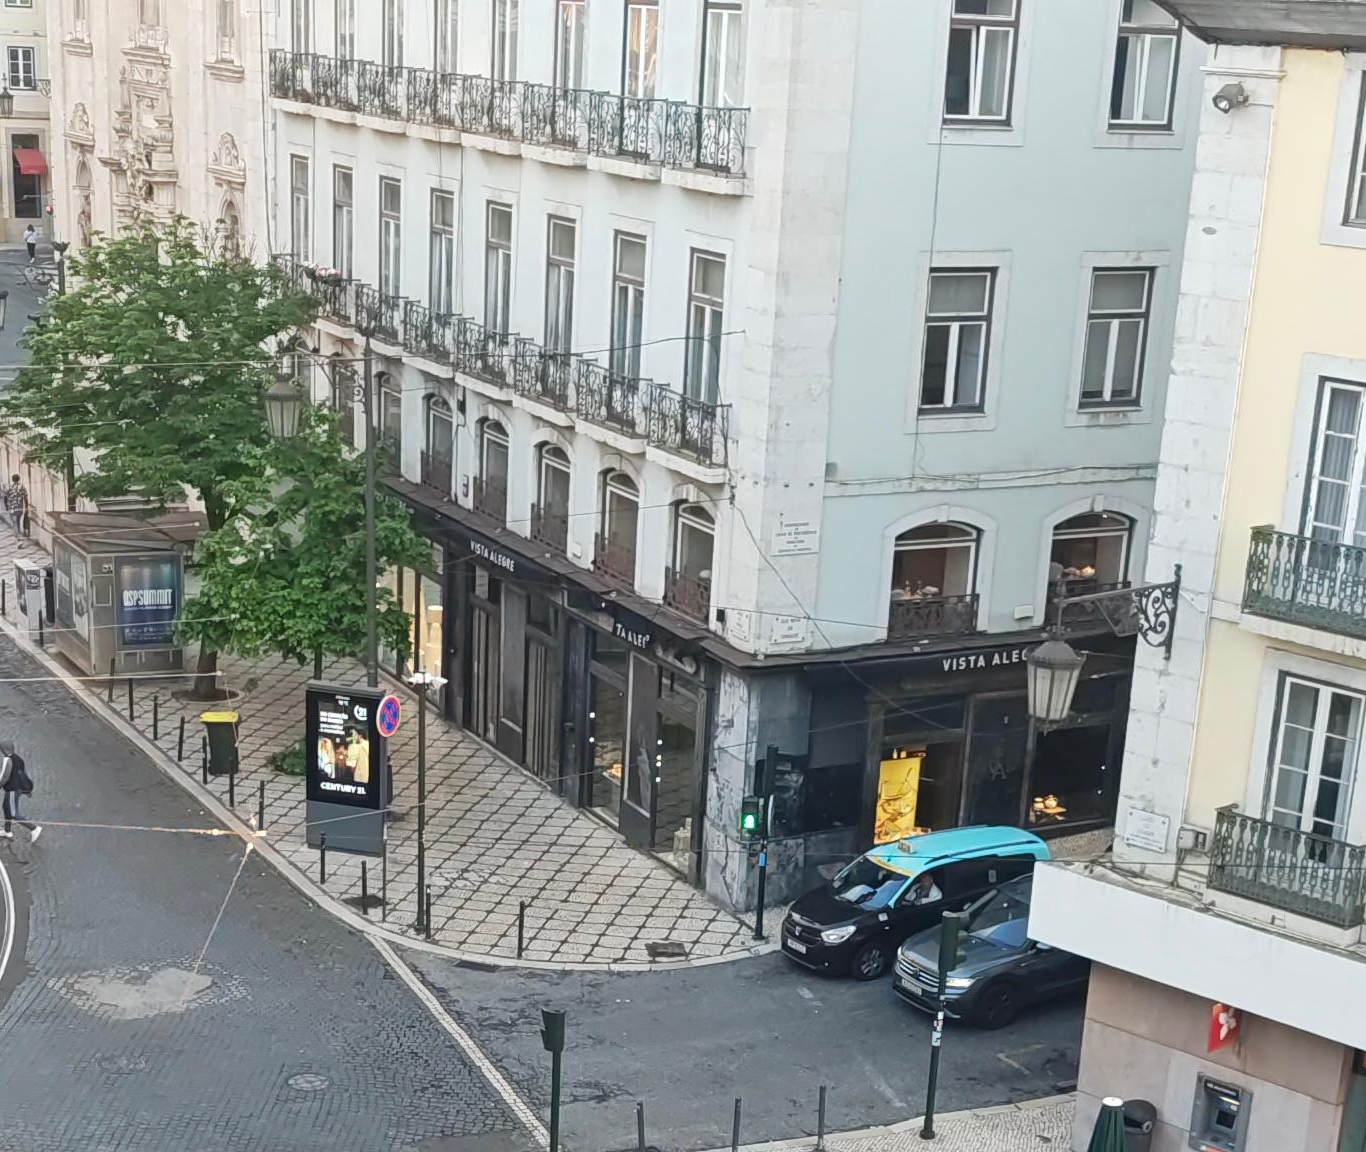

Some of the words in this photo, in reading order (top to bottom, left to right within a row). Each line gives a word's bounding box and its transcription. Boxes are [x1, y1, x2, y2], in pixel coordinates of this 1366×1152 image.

[470, 540, 489, 558] VISTA
[489, 551, 515, 572] ALEGRE
[942, 656, 985, 672] VISTA
[320, 782, 356, 794] CENTURY
